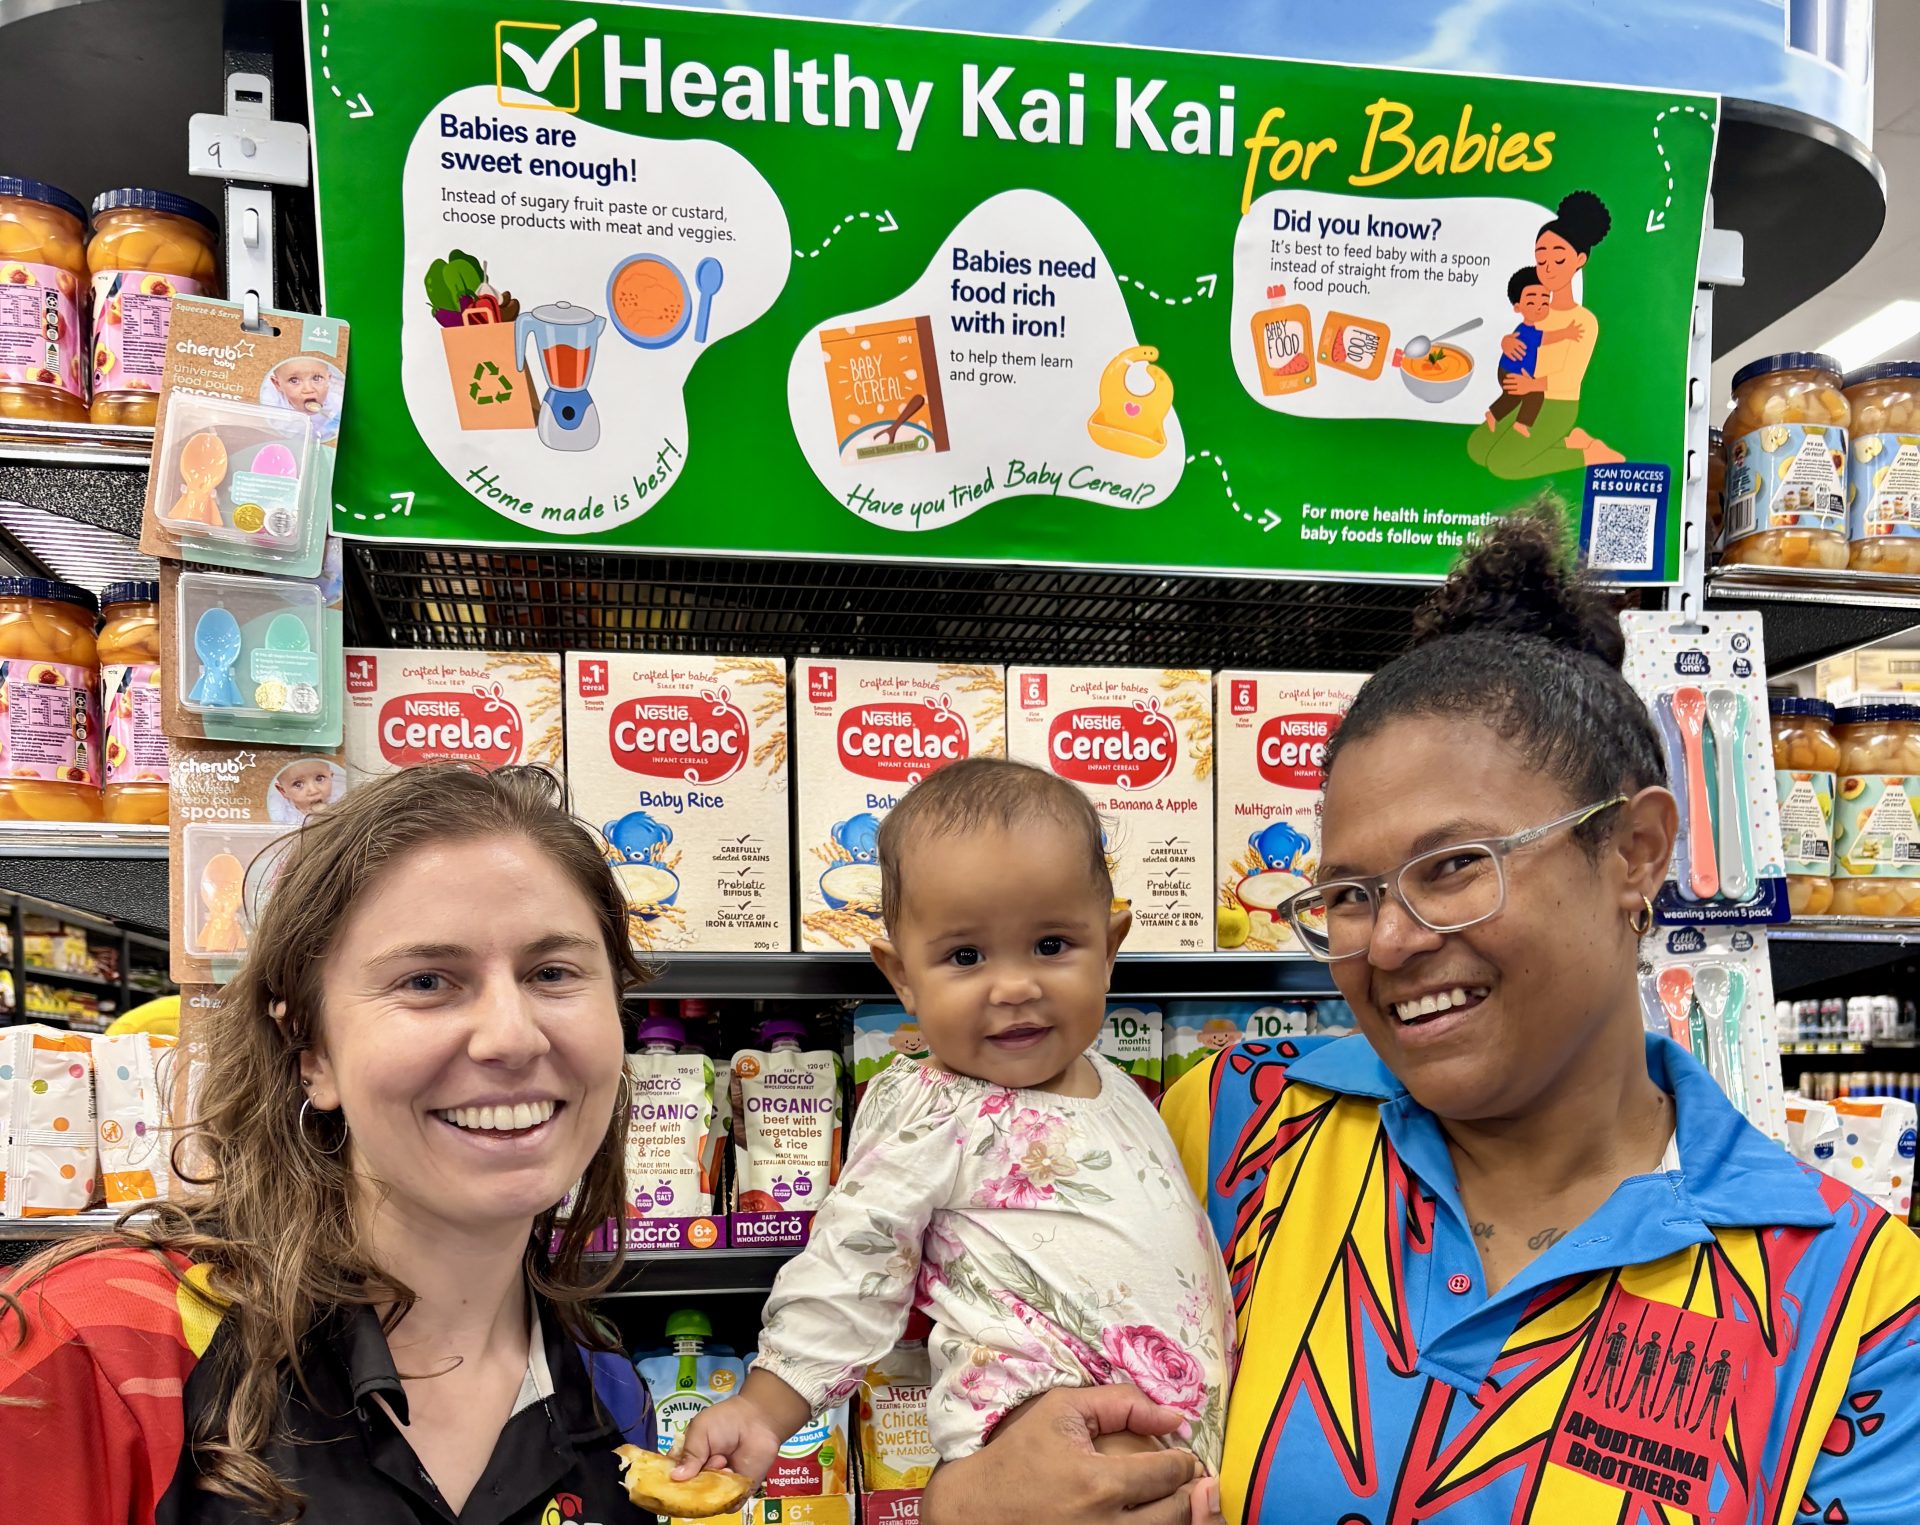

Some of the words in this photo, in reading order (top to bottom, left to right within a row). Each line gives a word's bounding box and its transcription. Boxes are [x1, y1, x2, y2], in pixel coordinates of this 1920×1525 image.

[440, 113, 528, 144] Babies
[536, 127, 577, 147] are
[603, 34, 934, 152] Healthy
[962, 63, 1085, 145] Kai
[1115, 76, 1235, 157] Kai
[1242, 107, 1337, 214] for
[1348, 98, 1555, 187] Babies
[207, 141, 222, 168] 9
[441, 151, 522, 175] sweet
[529, 156, 637, 187] enough!
[441, 187, 496, 205] Instead
[501, 191, 517, 206] of
[520, 196, 570, 213] sugary
[573, 195, 604, 212] fruit
[608, 201, 648, 216] paste
[652, 205, 667, 217] or
[672, 205, 728, 223] custard,
[442, 208, 496, 225] choose
[501, 212, 566, 230] products
[570, 216, 601, 232] with
[605, 221, 643, 235] meat
[646, 221, 674, 237] and
[678, 225, 736, 243] veggies.
[1273, 208, 1311, 232] Did
[1318, 217, 1360, 238] you
[1367, 214, 1442, 241] know?
[952, 248, 1032, 275] Babies
[1038, 257, 1096, 279] need
[1295, 240, 1322, 256] best
[1326, 245, 1340, 257] to
[1344, 243, 1372, 259] feed
[1376, 245, 1407, 264] baby
[1410, 247, 1437, 263] with
[1440, 253, 1448, 264] a
[1451, 254, 1491, 268] spoon
[1270, 258, 1317, 274] instead
[1320, 260, 1335, 275] of
[1337, 261, 1386, 280] straight
[1390, 265, 1420, 280] from
[1423, 266, 1444, 281] the
[1447, 267, 1479, 287] baby
[951, 279, 1005, 304] food
[1012, 283, 1056, 307] rich
[1293, 277, 1324, 292] food
[1327, 279, 1371, 296] pouch.
[175, 303, 209, 316] Squeeze
[210, 308, 217, 317] &
[218, 309, 241, 320] Serve
[951, 310, 1005, 335] with
[1012, 313, 1066, 338] iron!
[1265, 319, 1288, 340] BABY
[175, 340, 237, 360] cherub
[1267, 333, 1300, 360] FOOD
[213, 358, 236, 370] baby
[850, 353, 882, 381] BABY
[950, 351, 965, 364] to
[968, 348, 998, 368] help
[1001, 351, 1037, 367] them
[1040, 352, 1074, 369] learn
[174, 364, 229, 380] universal
[949, 368, 975, 382] and
[978, 372, 1017, 386] grow.
[172, 374, 202, 386] food
[205, 380, 244, 394] pouch
[853, 377, 905, 405] CEREAL
[466, 465, 534, 514] Home
[541, 496, 604, 522] made
[613, 494, 630, 512] is
[633, 437, 682, 499] best!
[1593, 468, 1618, 479] SCAN
[1619, 469, 1632, 480] TO
[1633, 470, 1664, 481] ACCESS
[847, 483, 903, 516] Have
[910, 499, 945, 528] you
[949, 466, 994, 508] tried
[1003, 459, 1062, 496] Baby
[1068, 465, 1156, 505] Cereal?
[1592, 480, 1663, 493] RESOURCES
[1302, 503, 1327, 519] For
[1330, 507, 1369, 522] more
[1373, 506, 1419, 523] health
[1300, 524, 1338, 544] baby
[1341, 526, 1383, 543] foods
[1387, 527, 1432, 545] follow
[1436, 530, 1463, 547] this
[633, 669, 669, 683] Crafted
[671, 669, 686, 682] for
[688, 671, 719, 684] babies
[383, 716, 512, 750] Cerelac
[614, 720, 738, 754] Cerelac
[842, 726, 959, 759] Cerelac
[1053, 730, 1167, 761] Cerelac
[680, 757, 709, 765] CEREALS
[639, 791, 683, 814] Baby
[688, 792, 724, 808] Rice
[1110, 799, 1154, 811] Banana
[1155, 799, 1164, 810] &
[1166, 799, 1198, 814] Apple
[1234, 804, 1293, 820] Multigrain
[1295, 807, 1311, 816] with
[182, 807, 250, 820] spoons
[721, 846, 761, 854] CAREFULLY
[717, 879, 765, 890] Probiotic
[717, 910, 754, 920] Source
[1663, 908, 1705, 920] weaning
[1705, 910, 1739, 920] spoons
[1741, 908, 1747, 917] 5
[1748, 907, 1773, 919] pack
[753, 942, 769, 950] 200g
[1109, 1017, 1150, 1038] 10+
[1254, 1016, 1293, 1037] 10+
[1118, 1037, 1151, 1045] months
[747, 1097, 833, 1113] ORGANIC
[763, 1115, 789, 1125] beef
[792, 1115, 817, 1125] with
[760, 1128, 822, 1138] vegetables
[774, 1138, 783, 1149] &
[786, 1139, 808, 1150] rice
[693, 1225, 712, 1236] 6+
[713, 1373, 731, 1386] 6+
[882, 1411, 928, 1430] Chicke
[800, 1431, 824, 1442] SUGAR
[1563, 1410, 1709, 1482] APUDTHAMA
[778, 1466, 801, 1475] beef
[801, 1467, 810, 1475] &
[1566, 1440, 1692, 1506] BROTHERS
[769, 1476, 820, 1487] vegetables
